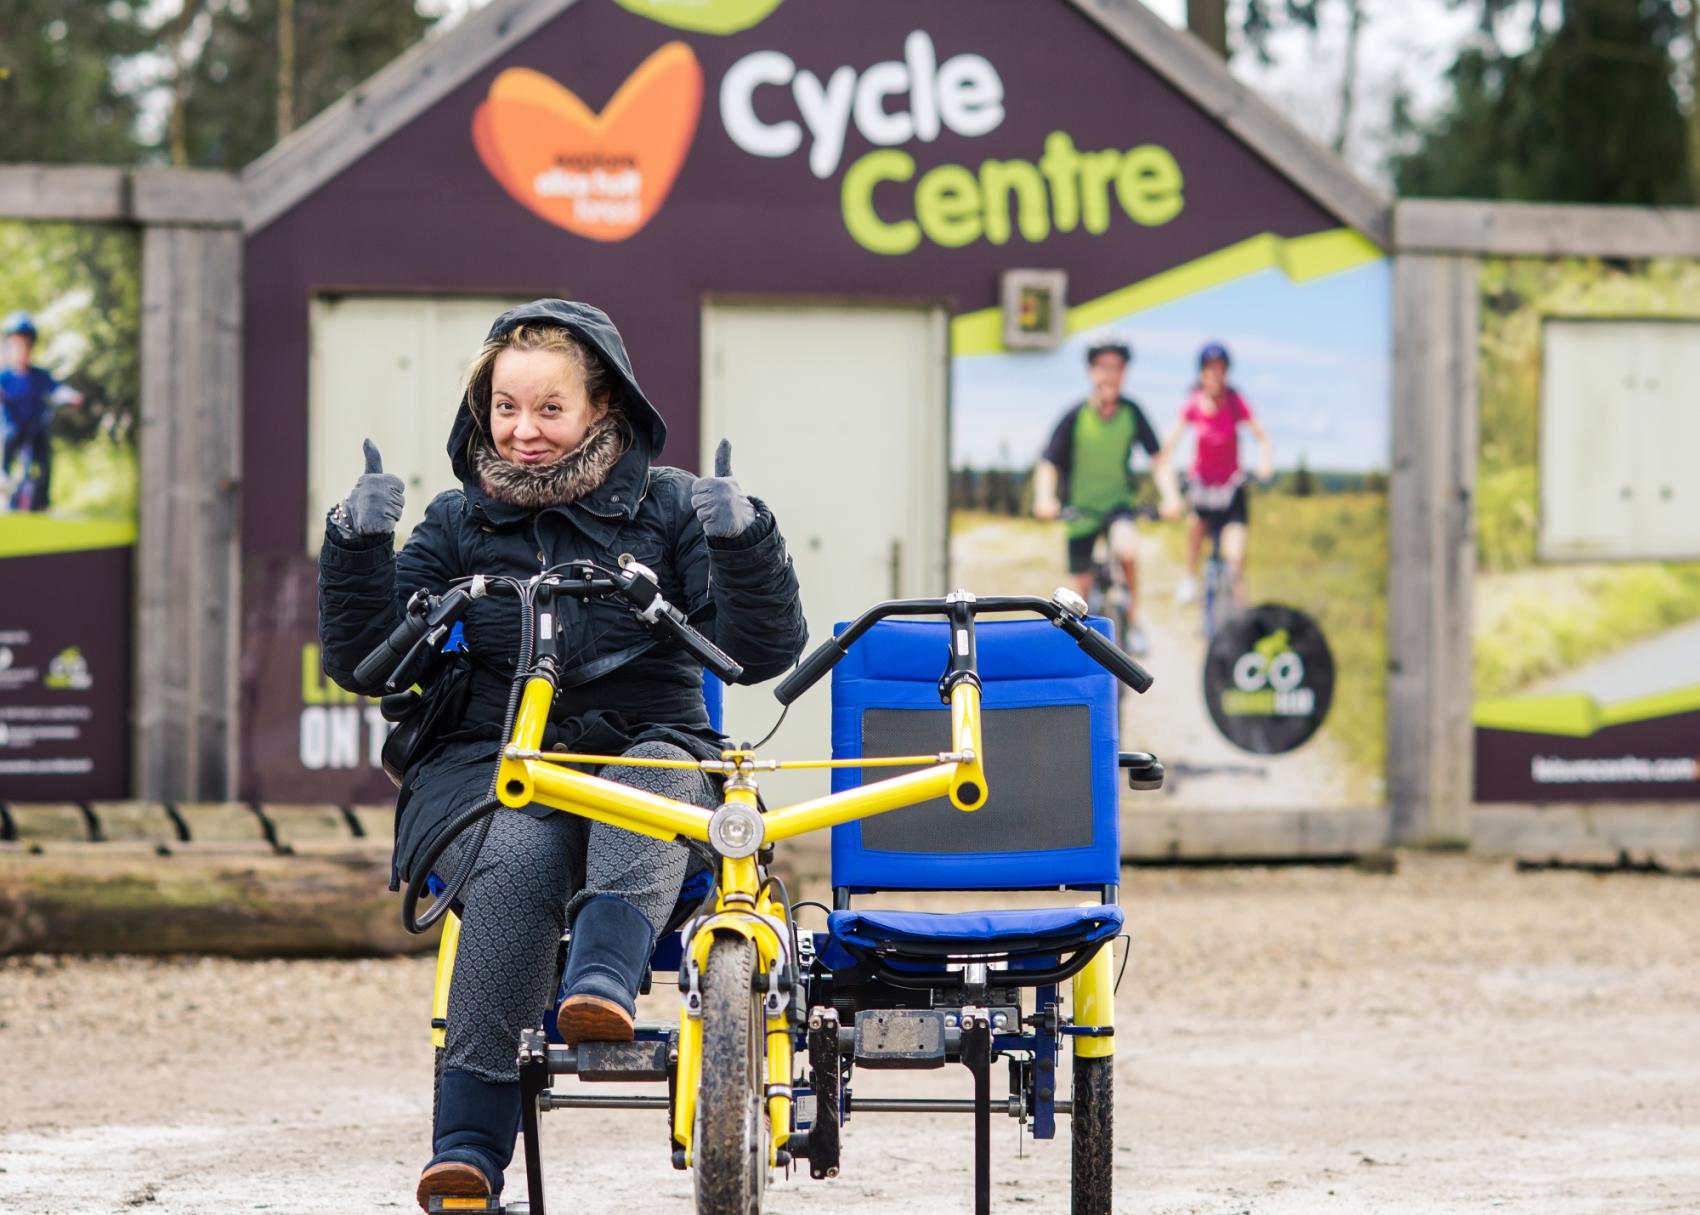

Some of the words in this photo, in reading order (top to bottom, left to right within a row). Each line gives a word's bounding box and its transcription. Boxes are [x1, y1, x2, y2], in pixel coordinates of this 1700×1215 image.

[720, 30, 1005, 178] Cycle
[842, 132, 1184, 254] Centre
[301, 706, 360, 769] ON
